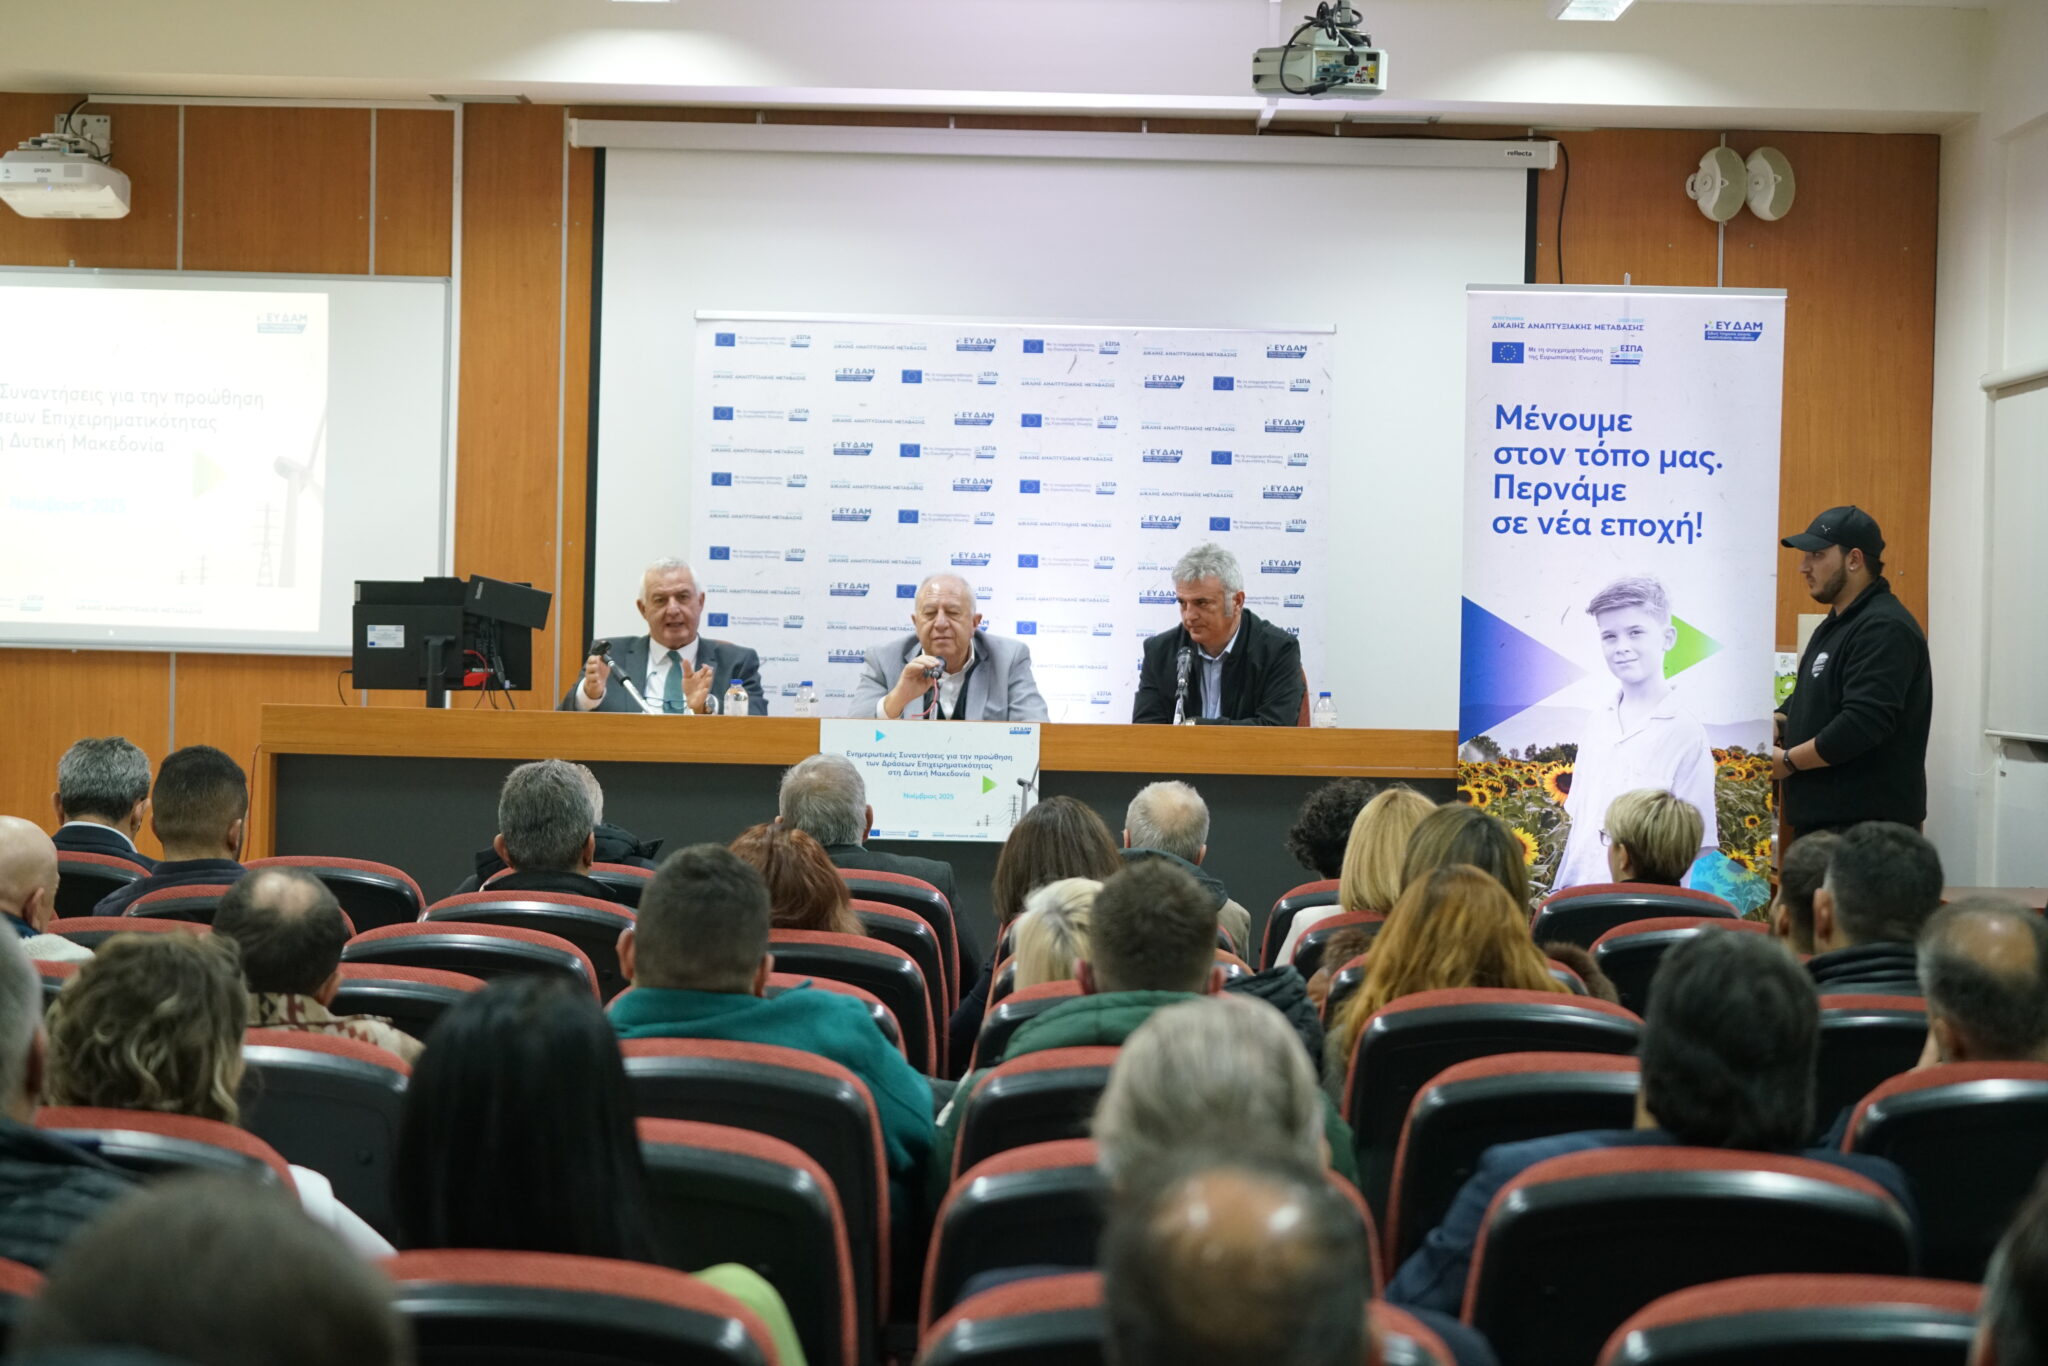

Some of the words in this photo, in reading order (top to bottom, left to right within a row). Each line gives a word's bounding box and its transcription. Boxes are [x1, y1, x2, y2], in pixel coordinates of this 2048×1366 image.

[266, 312, 308, 322] ΕΥΔΑΜ
[1716, 321, 1763, 330] ΕΥΔΑΜ
[963, 338, 996, 346] ΕΥΔΑΜ
[1274, 345, 1307, 353] ΕΥΔΑΜ
[842, 368, 875, 376] ΕΥΔΑΜ
[1152, 375, 1185, 383] ΕΥΔΑΜ
[0, 383, 103, 406] Συναντήσεις
[109, 391, 134, 407] για
[140, 392, 168, 408] την
[175, 388, 264, 410] προώθηση
[961, 412, 994, 420] ΕΥΔΑΜ
[42, 409, 218, 433] Επιχειρηματικότητας
[1272, 419, 1305, 427] ΕΥΔΑΜ
[1495, 404, 1632, 438] Μένουμε
[10, 432, 66, 453] Δυτική
[72, 434, 164, 452] Μακεδονία
[840, 442, 873, 450] ΕΥΔΑΜ
[1150, 449, 1183, 457] ΕΥΔΑΜ
[1494, 446, 1566, 466] στον
[1576, 442, 1650, 467] τόπο
[1660, 449, 1723, 476] μας.
[960, 478, 993, 486] ΕΥΔΑΜ
[1270, 486, 1303, 494] ΕΥΔΑΜ
[1494, 474, 1626, 506] Περνάμε
[839, 508, 872, 516] ΕΥΔΑΜ
[1148, 515, 1181, 523] ΕΥΔΑΜ
[1492, 514, 1528, 534] σε
[1538, 510, 1591, 536] νέα
[1601, 512, 1702, 544] εποχή!
[958, 552, 991, 560] ΕΥΔΑΜ
[1268, 560, 1301, 568] ΕΥΔΑΜ
[837, 583, 870, 591] ΕΥΔΑΜ
[846, 750, 897, 760] Ενημερωτικές
[899, 751, 944, 760] Συναντήσεις
[974, 753, 1012, 762] προώθηση
[882, 760, 915, 768] Δράσεων
[918, 761, 992, 770] Επιχειρηματικότητας
[904, 769, 928, 777] Δυτική
